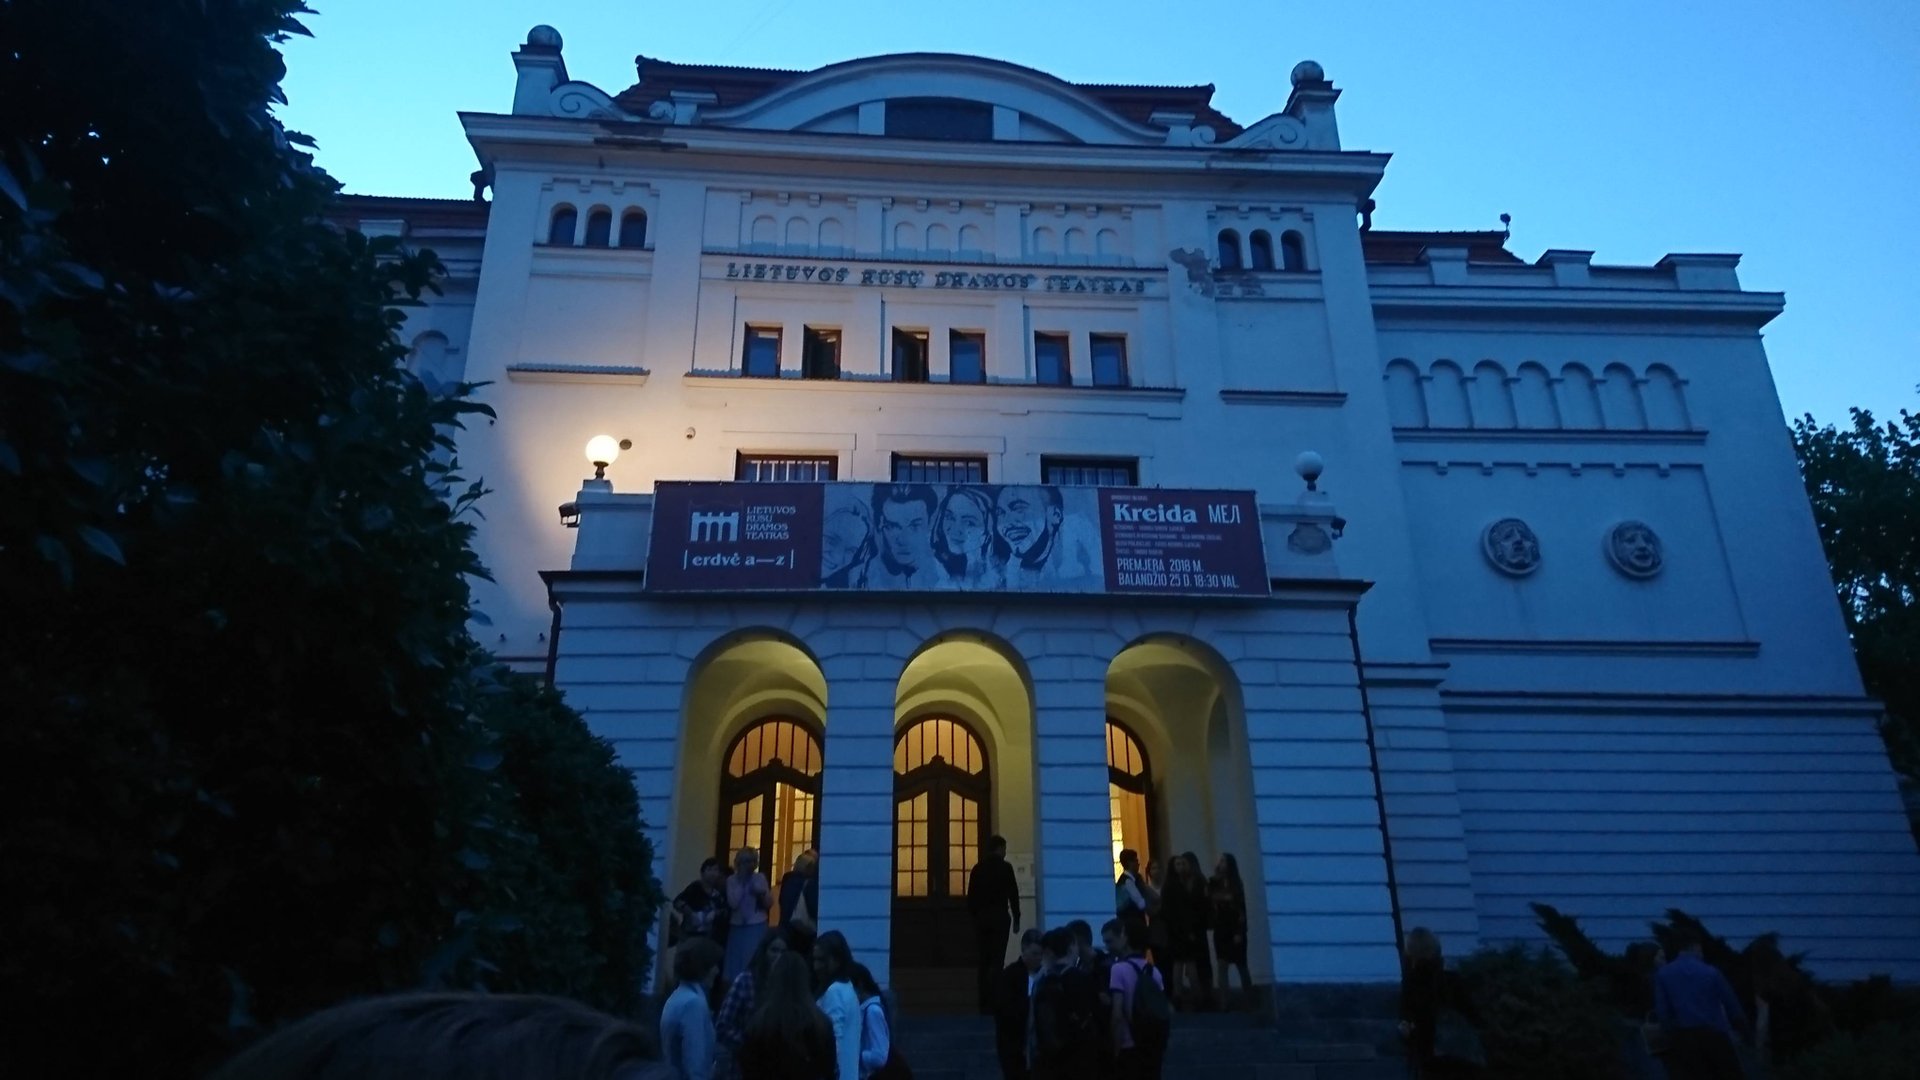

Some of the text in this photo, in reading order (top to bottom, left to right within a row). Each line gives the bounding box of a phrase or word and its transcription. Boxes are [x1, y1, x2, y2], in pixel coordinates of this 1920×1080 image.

[726, 262, 850, 283] LIETUVOS
[934, 272, 1034, 289] DRAMOS
[1044, 275, 1147, 294] TEATRAS
[746, 505, 797, 515] LIETUVOS
[1113, 503, 1198, 523] Kreida
[745, 523, 788, 532] DRAMOS
[745, 531, 789, 540] TEATRAS
[1116, 557, 1205, 573] PREMJERA 2018 M.
[1118, 570, 1240, 589] BALANDŽIO 25 D. 18:30 VAL.
